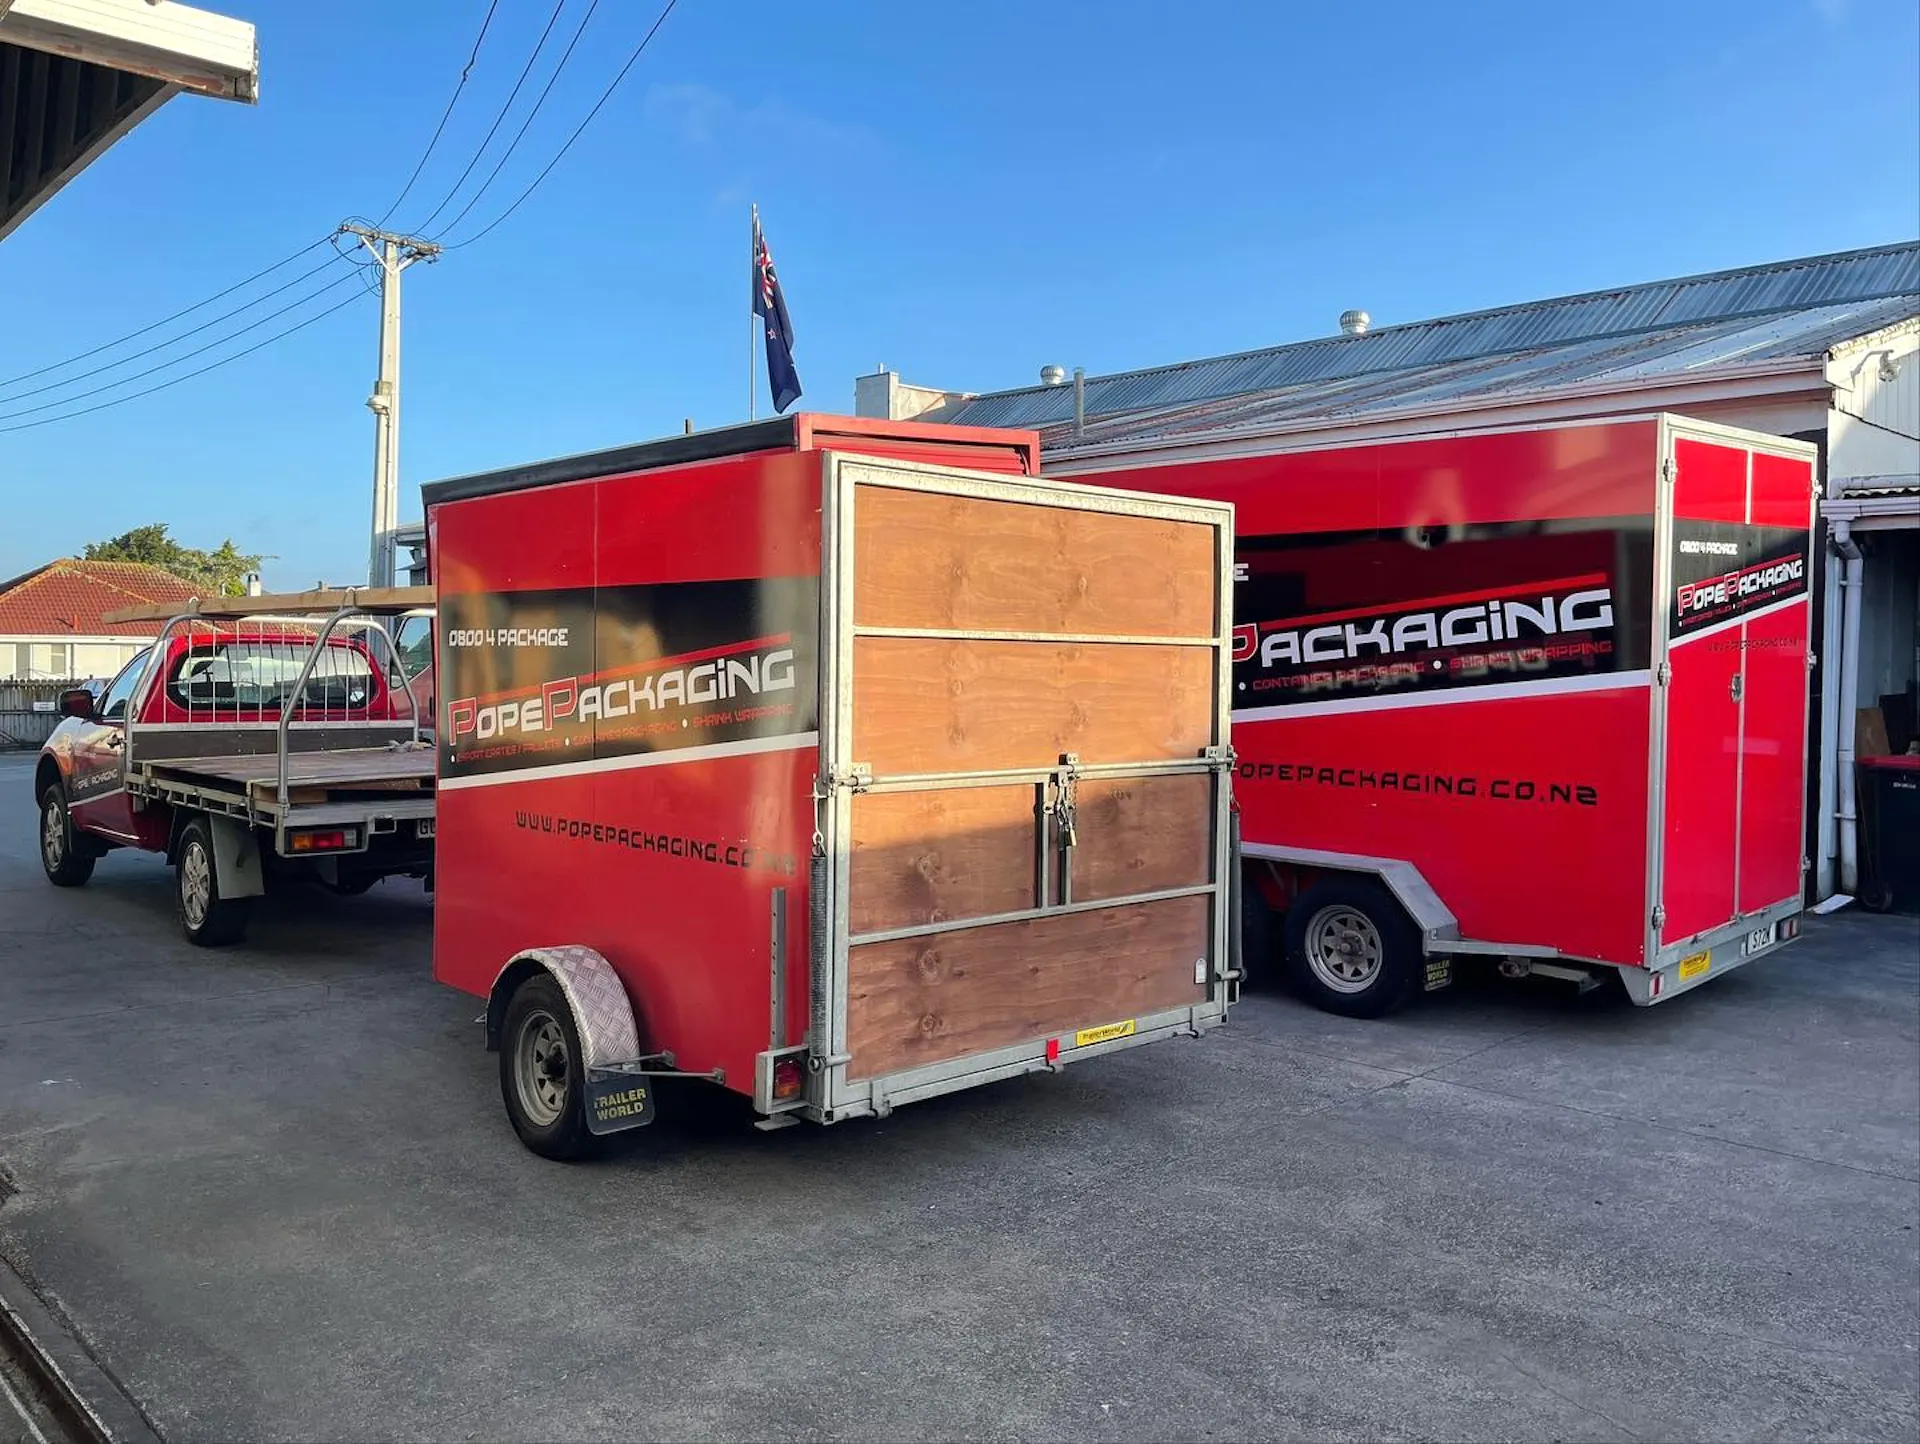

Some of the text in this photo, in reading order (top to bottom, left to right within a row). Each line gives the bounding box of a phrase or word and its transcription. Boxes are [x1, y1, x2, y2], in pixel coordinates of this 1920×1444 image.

[448, 628, 569, 646] 0800 4 PACKAGE
[1516, 640, 1613, 662] WRAPPING
[594, 1088, 647, 1109] TRAILER
[597, 1101, 644, 1121] WORLD
